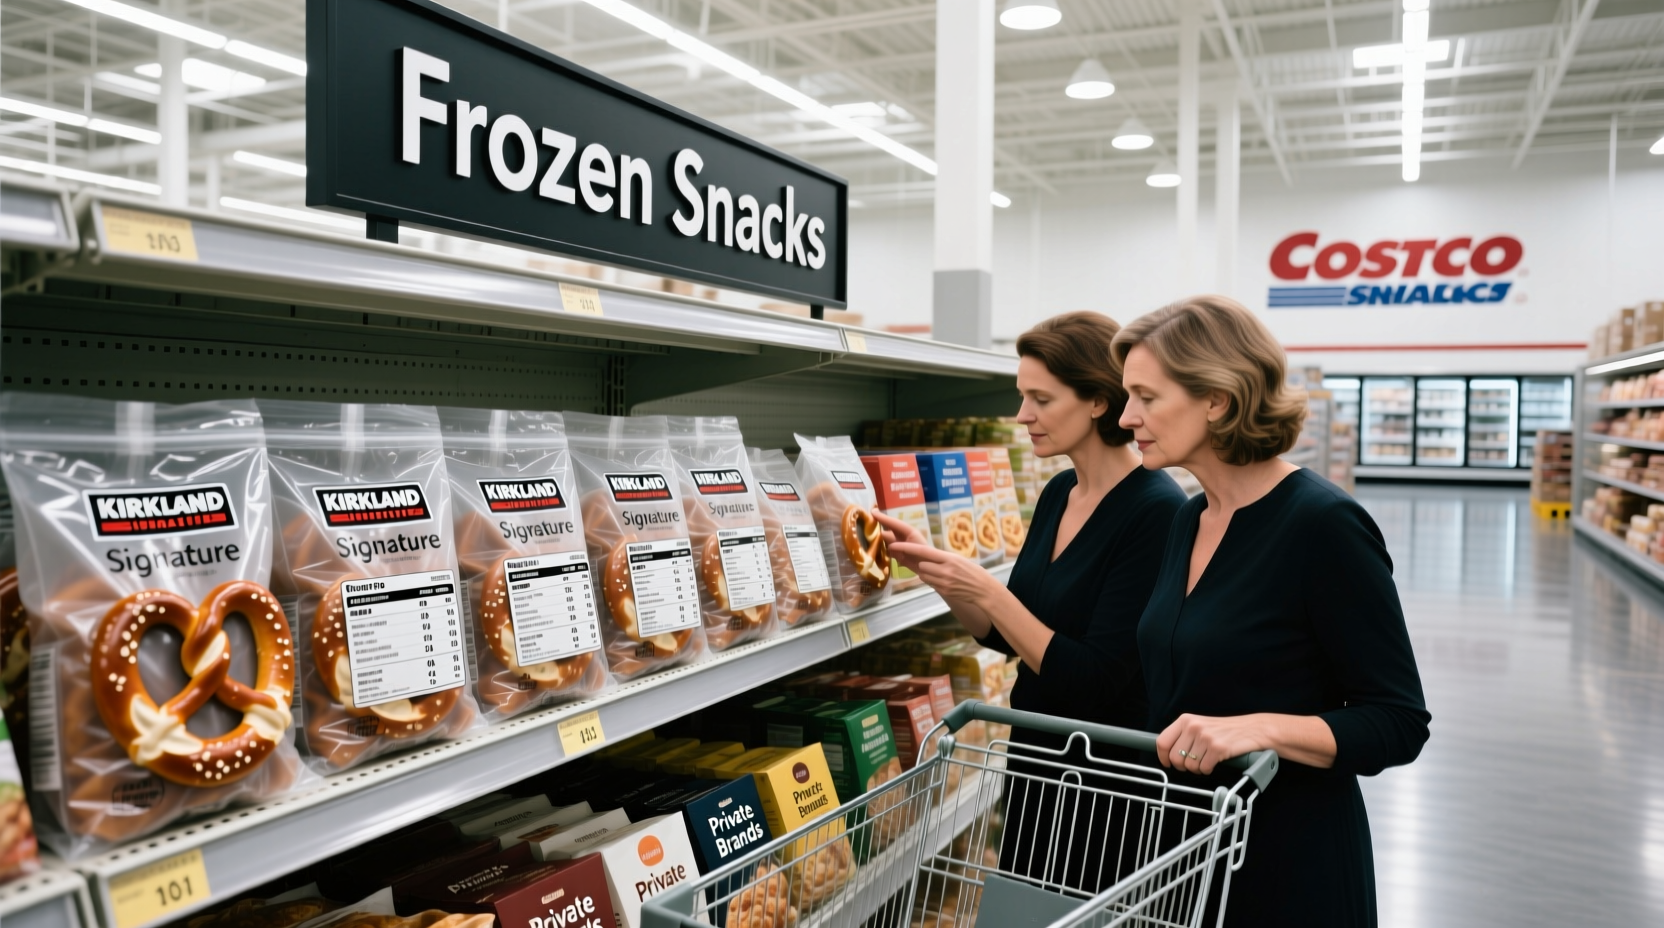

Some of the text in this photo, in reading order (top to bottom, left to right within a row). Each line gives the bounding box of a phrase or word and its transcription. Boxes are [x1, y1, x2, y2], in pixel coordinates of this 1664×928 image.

[402, 46, 827, 270] Frozen Snacks
[1269, 231, 1524, 280] COSTCO
[97, 491, 225, 520] KIRKLAND
[322, 488, 421, 512] KIRKLAND
[484, 482, 557, 500] KIRKLAND
[106, 543, 240, 578] Signature
[336, 533, 441, 563] Signature
[707, 804, 755, 837] Private
[715, 820, 764, 858] Brands
[155, 875, 193, 906] 101
[635, 864, 687, 903] Private
[528, 895, 596, 928] Private
